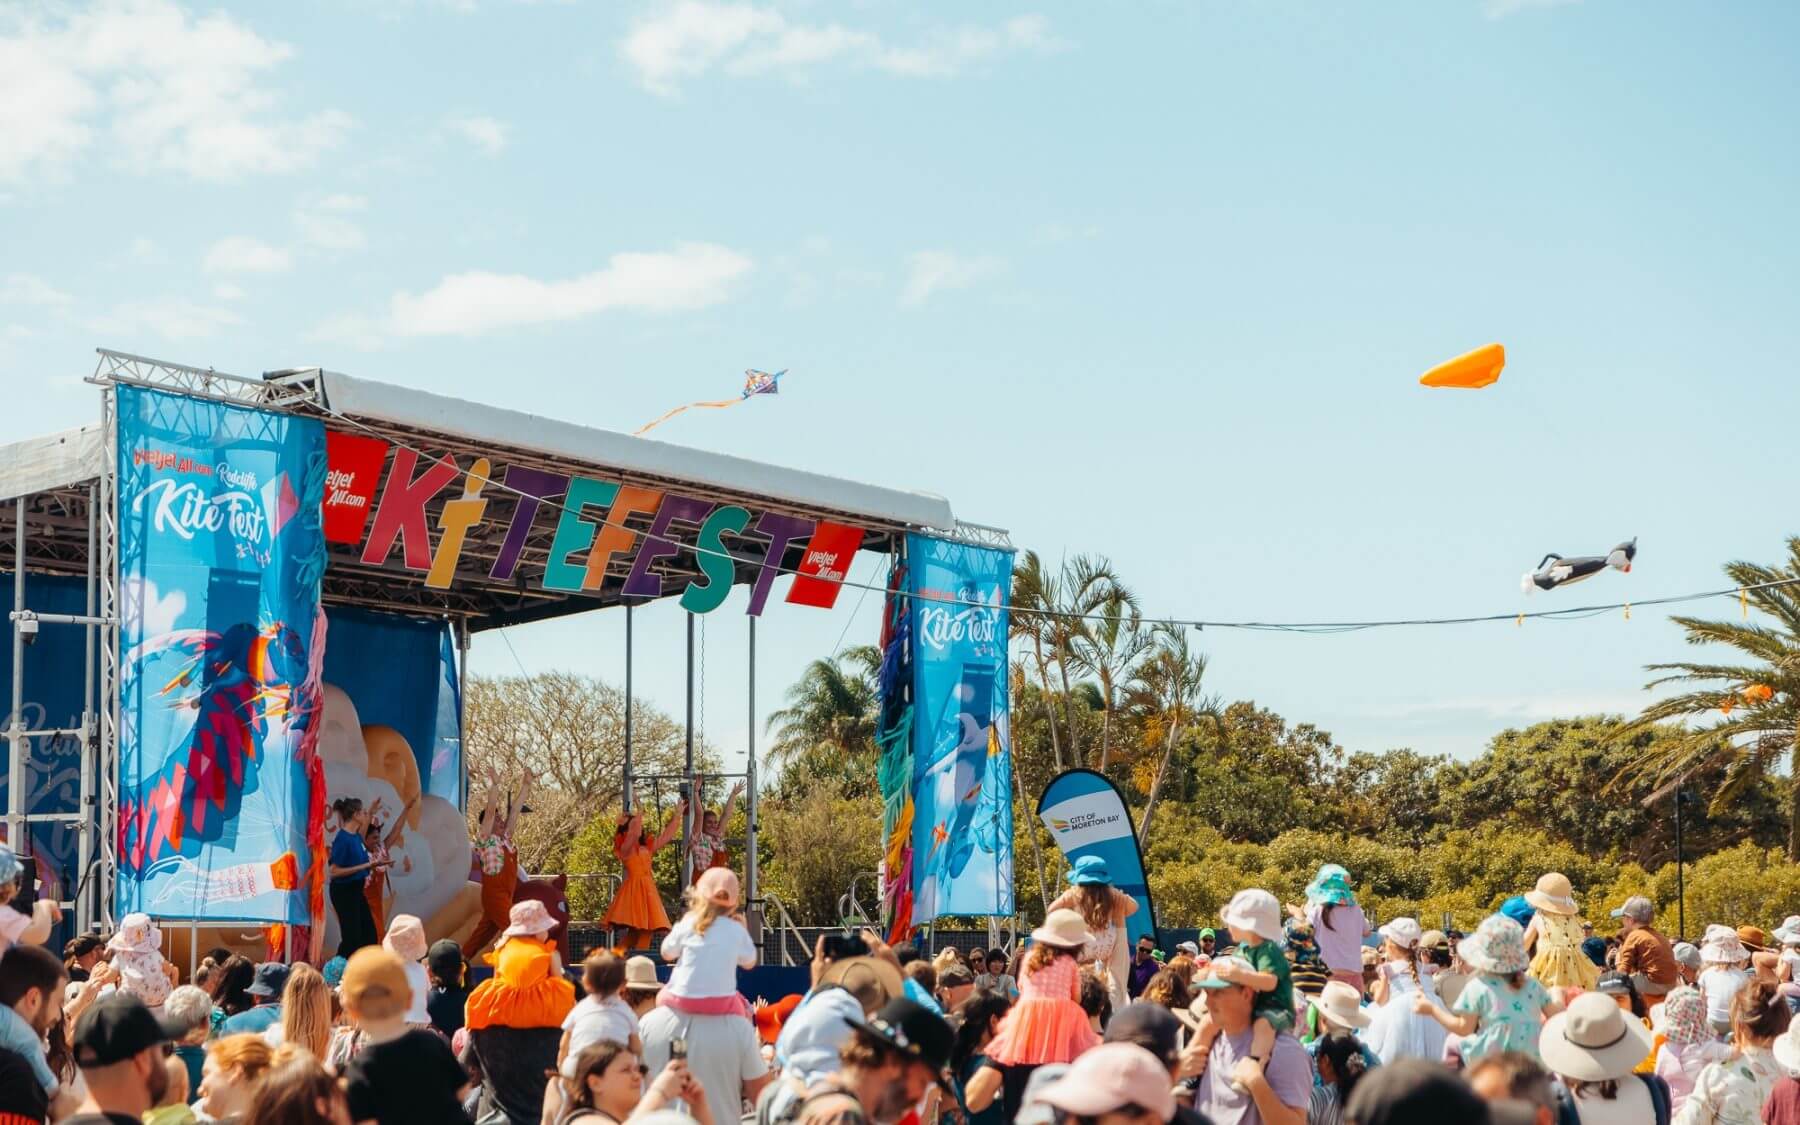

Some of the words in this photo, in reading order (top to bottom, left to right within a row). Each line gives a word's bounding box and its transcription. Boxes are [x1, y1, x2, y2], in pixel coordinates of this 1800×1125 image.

[132, 478, 225, 540] Kite
[211, 491, 265, 545] Fest
[919, 607, 966, 650] Kite
[955, 606, 995, 644] Fest
[1070, 815, 1085, 824] CITY
[1086, 812, 1096, 820] OF
[1071, 818, 1106, 830] MORETON
[1107, 814, 1120, 823] BAY
